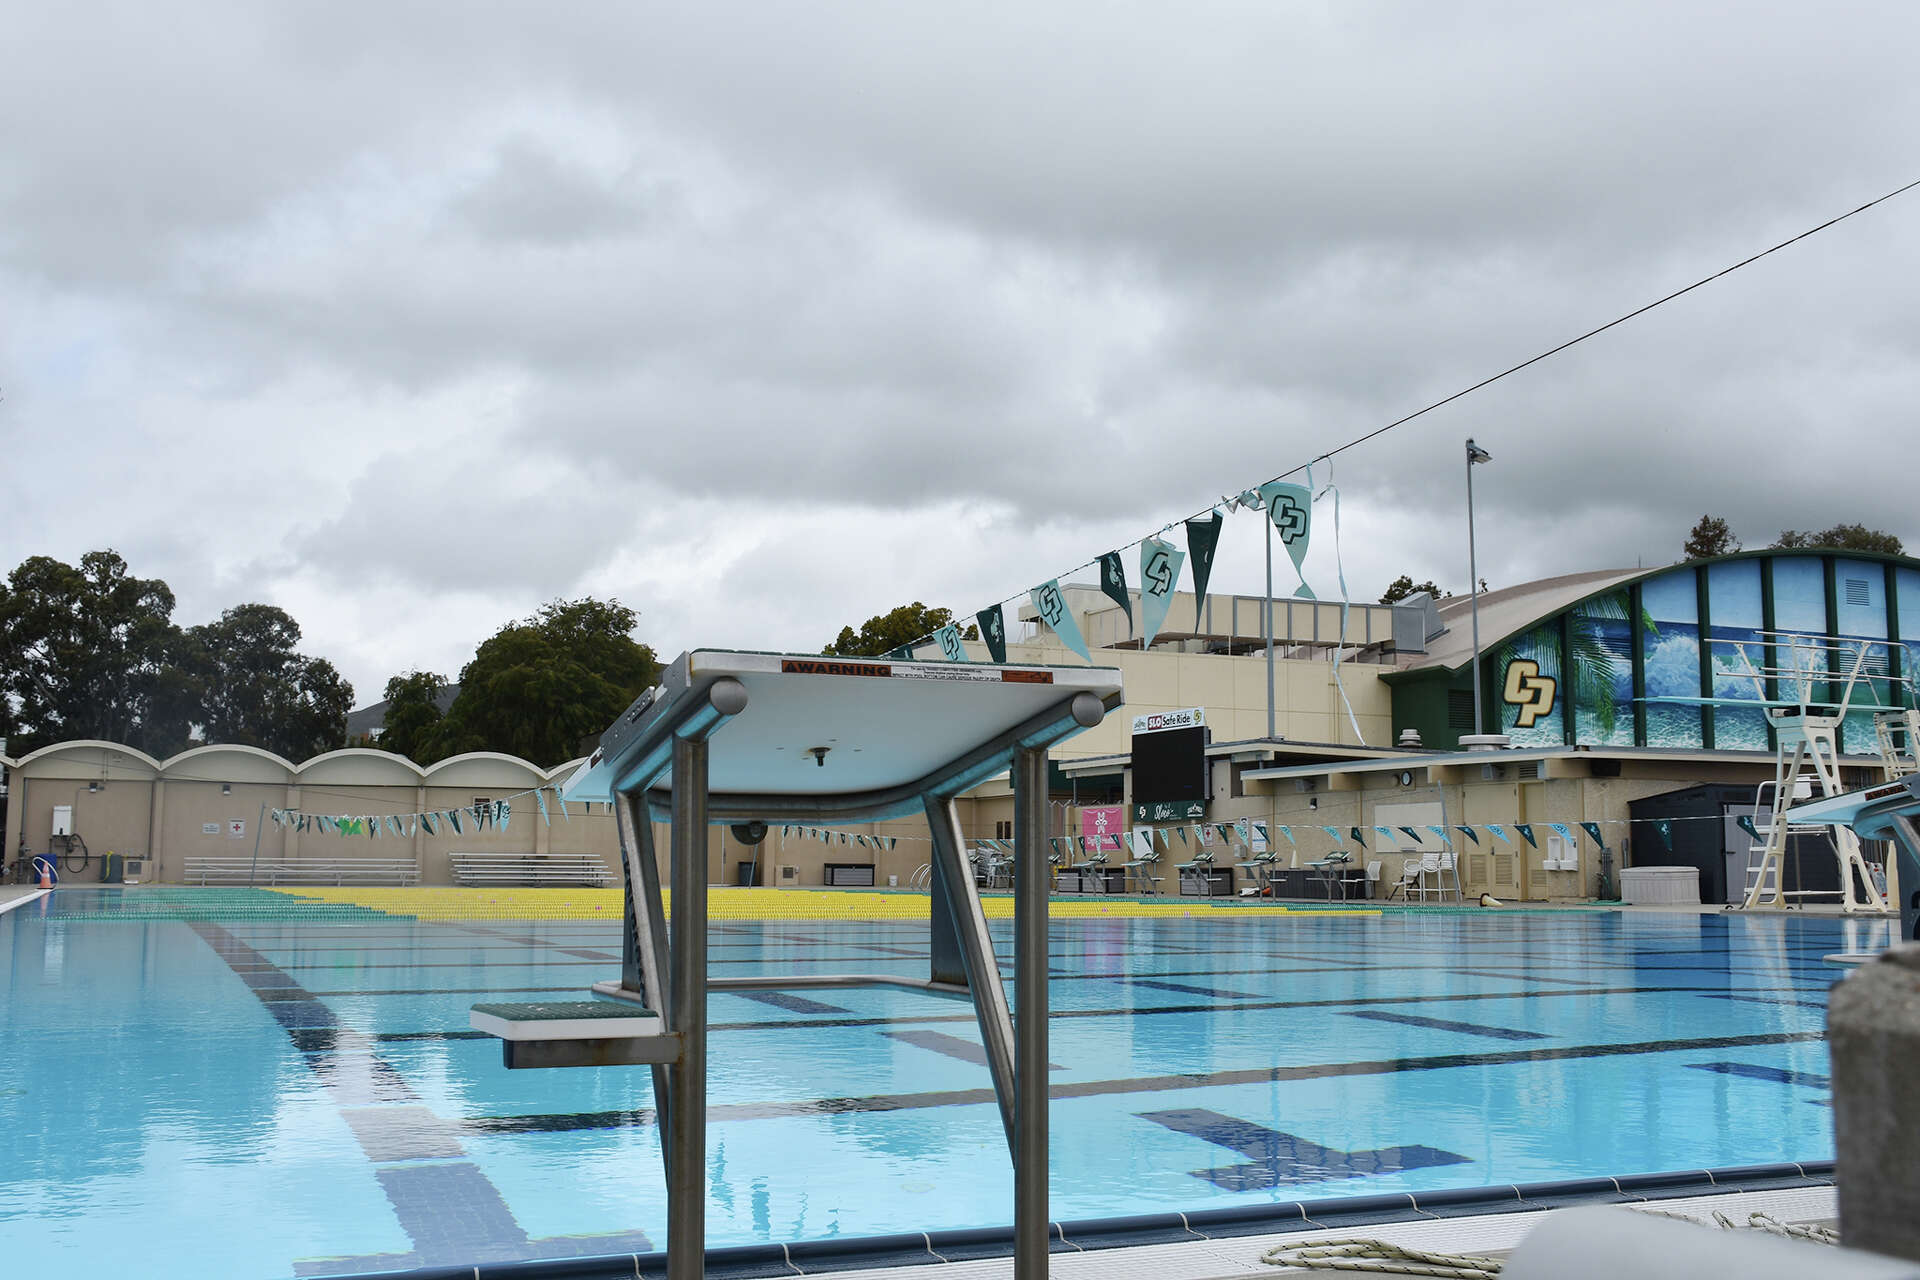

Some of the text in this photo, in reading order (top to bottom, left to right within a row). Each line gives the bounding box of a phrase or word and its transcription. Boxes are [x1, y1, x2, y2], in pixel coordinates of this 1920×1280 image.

[797, 663, 890, 676] WARNING
[1503, 659, 1557, 728] CP
[1148, 717, 1162, 729] SLO
[1162, 715, 1176, 726] Safe
[1176, 713, 1191, 725] Ride
